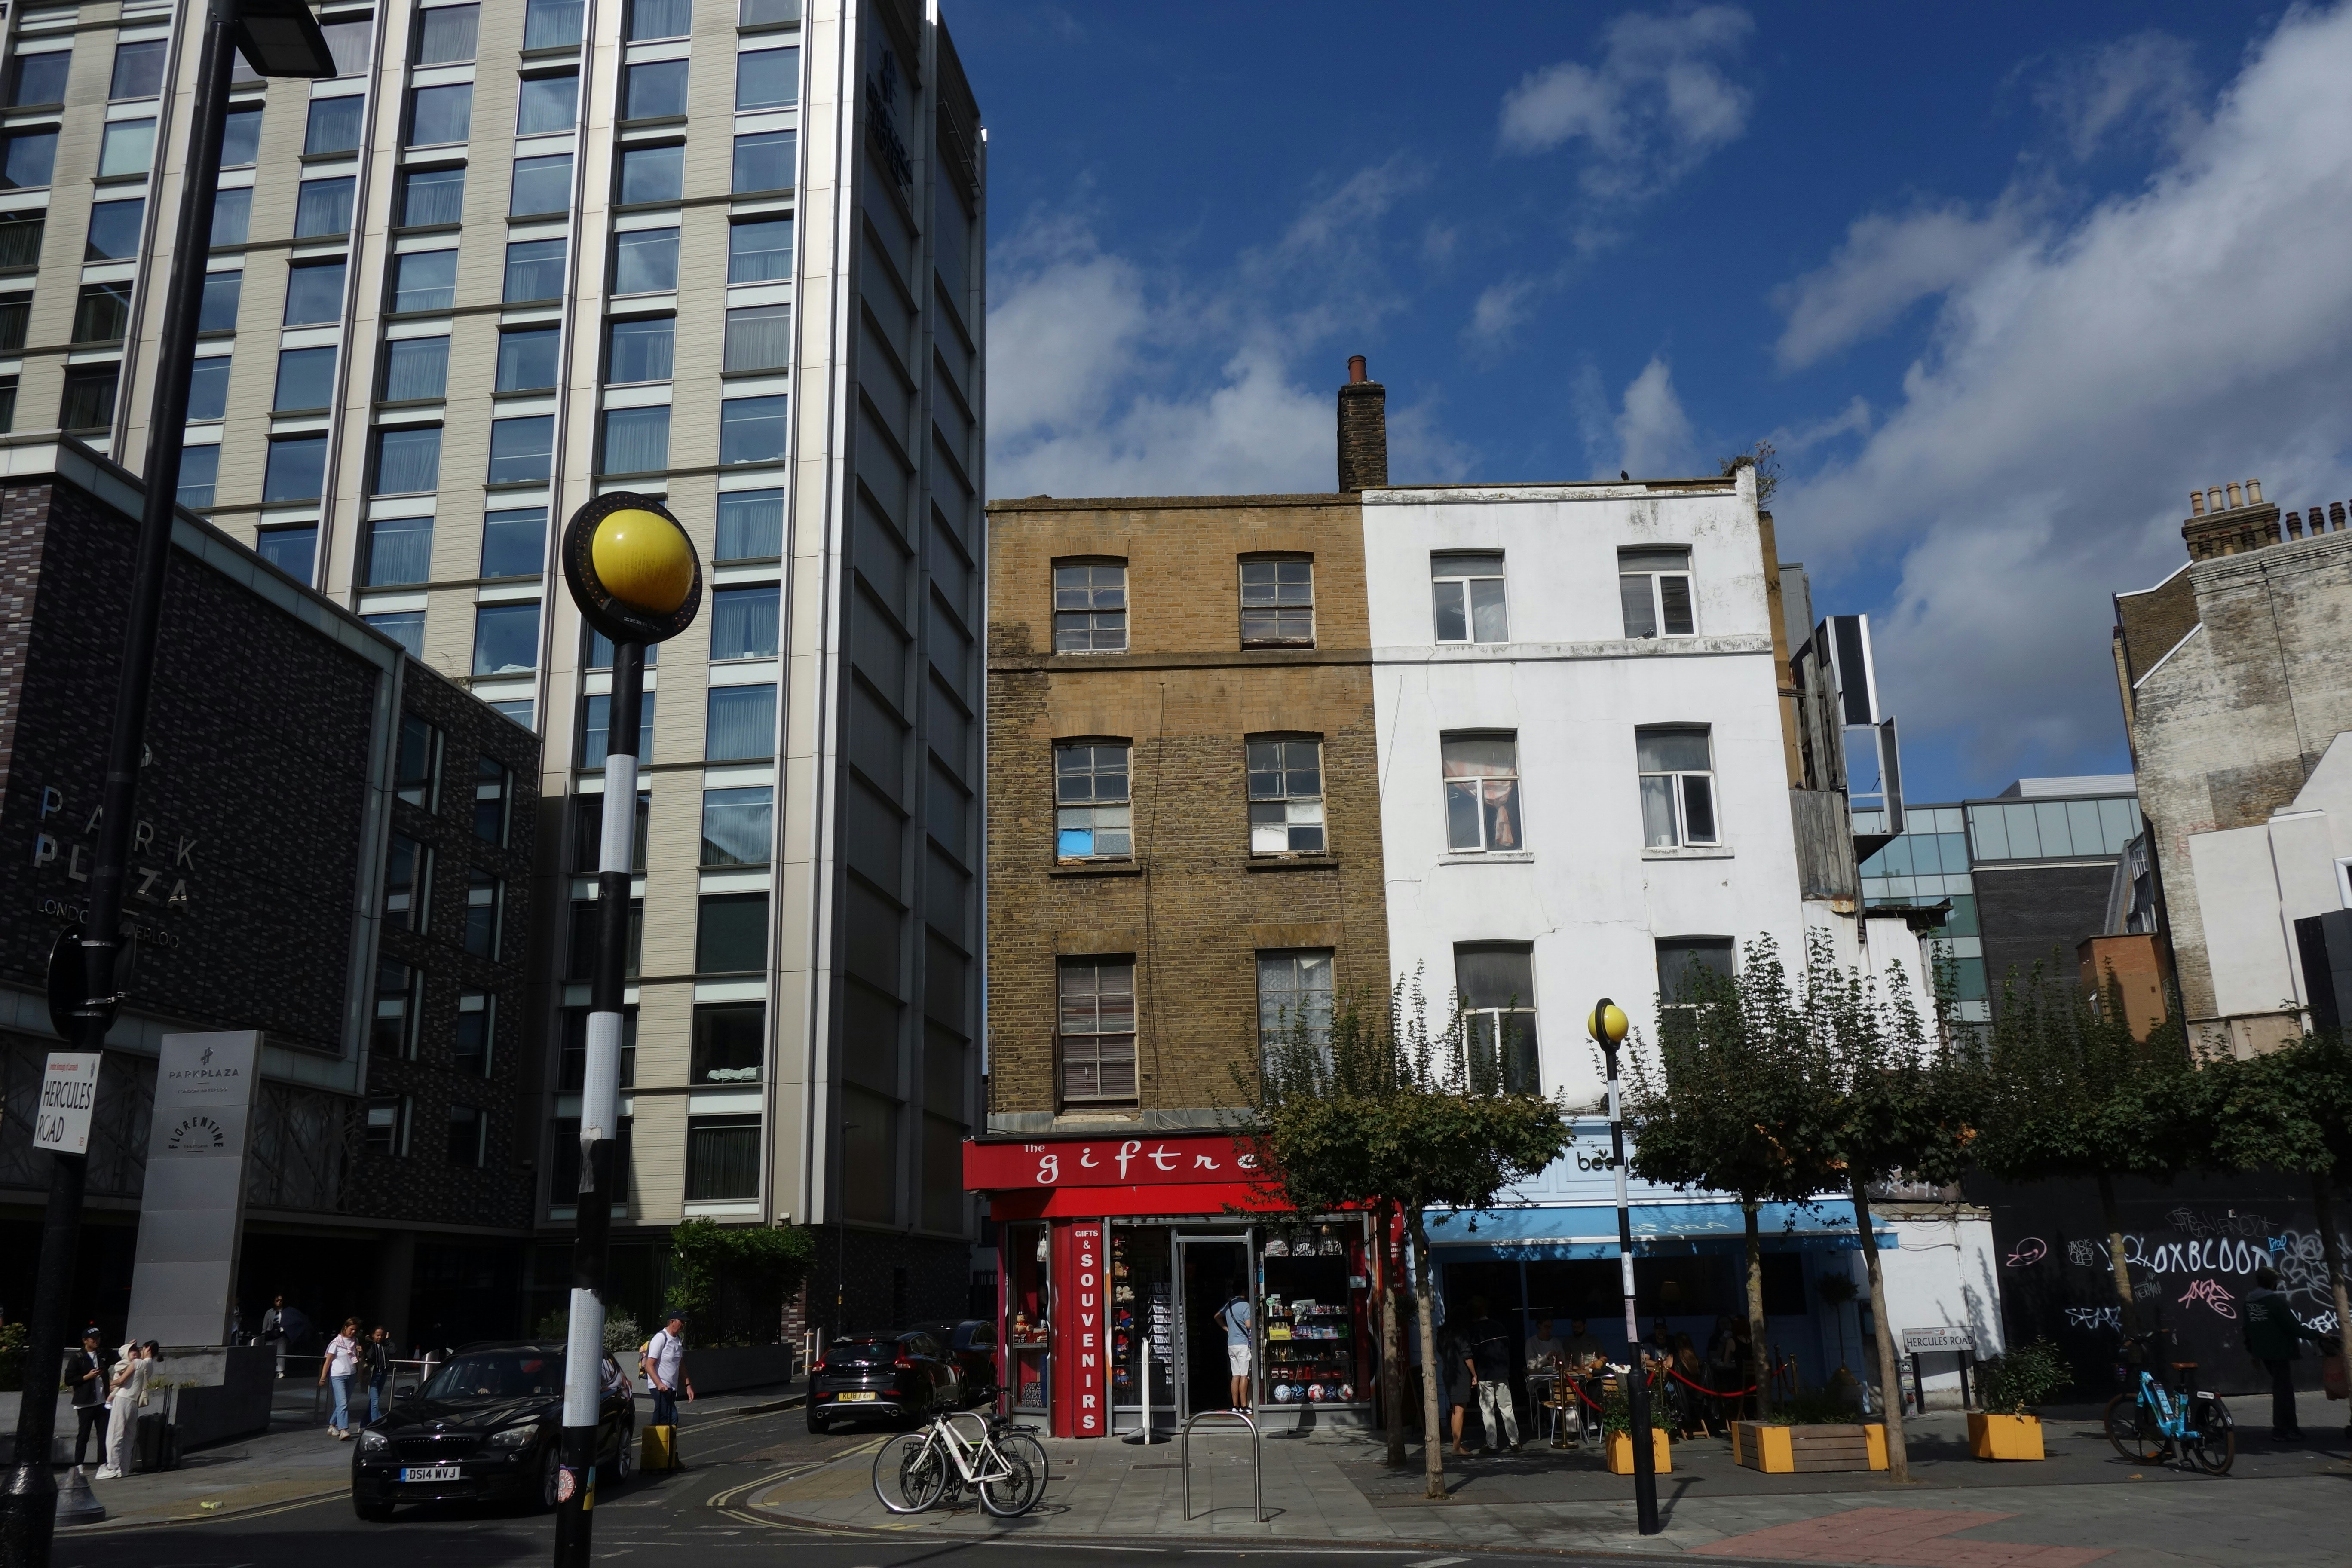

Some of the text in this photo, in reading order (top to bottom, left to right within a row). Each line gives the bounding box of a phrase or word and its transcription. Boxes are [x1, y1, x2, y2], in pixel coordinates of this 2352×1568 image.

[40, 785, 198, 871] PARK
[33, 833, 189, 914] PLZA
[37, 899, 89, 924] LONDO
[43, 1081, 92, 1110] HERCULES
[37, 1114, 64, 1142] ROAD
[168, 1117, 223, 1149] FLORENTINE
[1023, 1144, 1045, 1153] The
[1036, 1140, 1257, 1184] giftre
[1083, 1240, 1090, 1249] &
[1081, 1254, 1095, 1429] SOUVENIRS
[1906, 1336, 1973, 1347] HERCULES ROAD
[410, 1468, 456, 1479] DS14 WVJ
